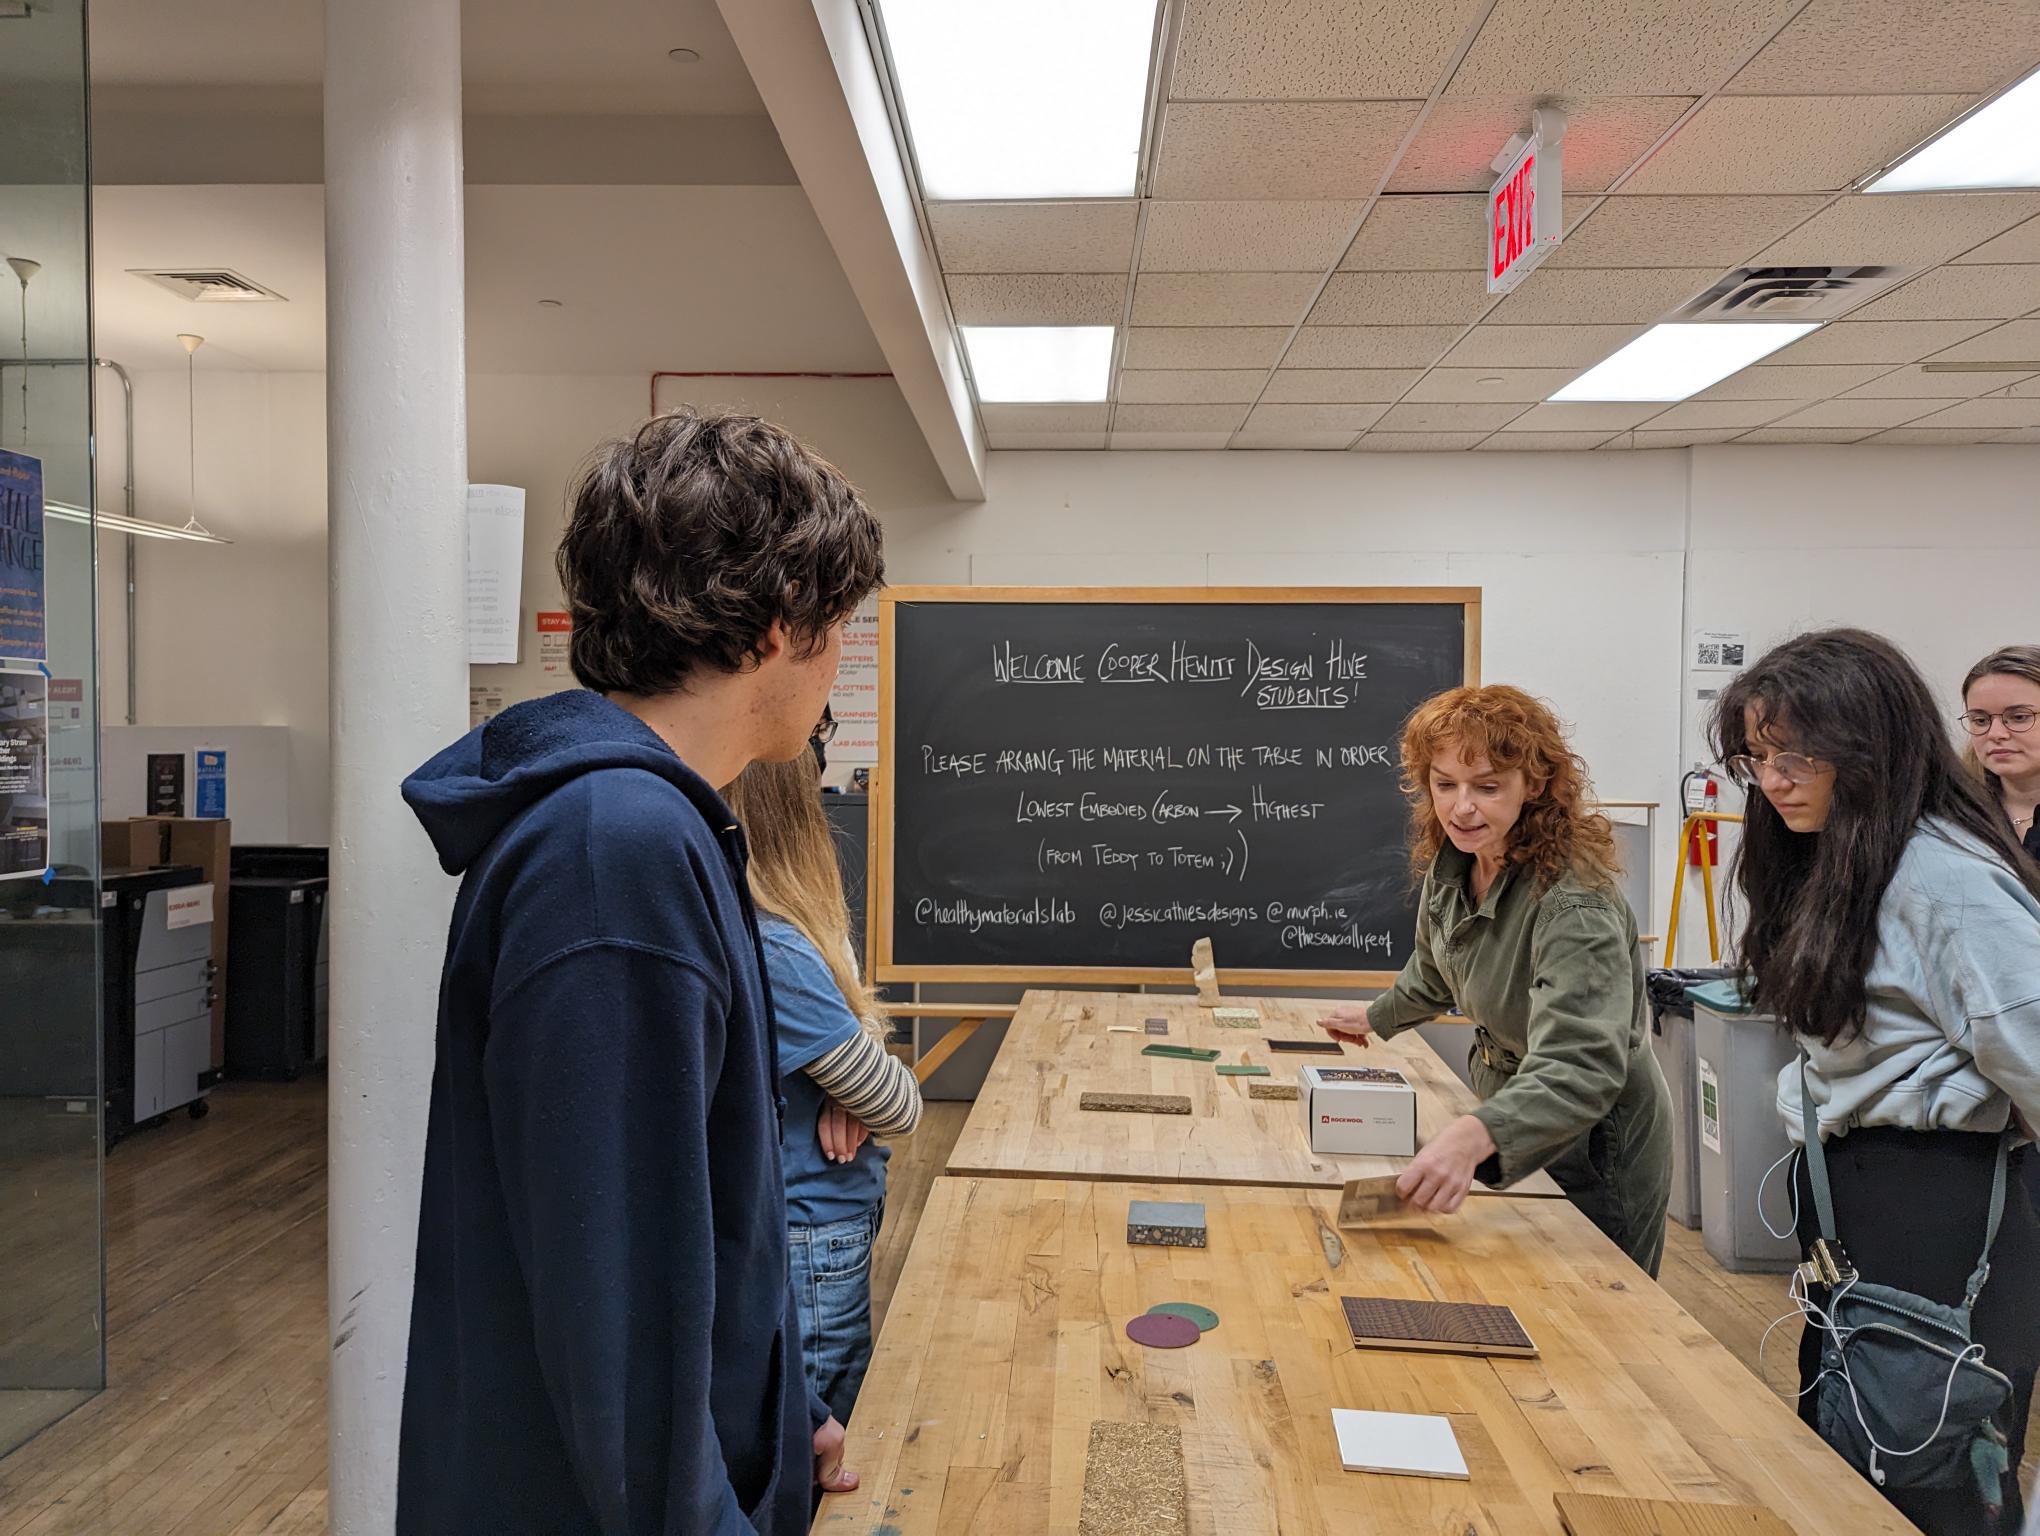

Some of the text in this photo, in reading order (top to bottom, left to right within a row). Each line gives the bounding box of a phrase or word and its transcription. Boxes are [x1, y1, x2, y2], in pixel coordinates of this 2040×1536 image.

[1494, 154, 1534, 279] EXIT
[993, 638, 1367, 697] WELCOME COOPER HEWITT DESIGN HIVE
[1257, 682, 1358, 708] STUDENTS!
[922, 744, 1391, 777] PLEASE ARRANG THE MATERIAL ON THE TABLE IN ORDER
[1017, 784, 1324, 824] LOWEST EMBODIED CARBON HIGHEST
[1038, 838, 1083, 872] (FROM
[1092, 844, 1139, 870] TEDDY
[1147, 852, 1164, 866] TO
[1168, 847, 1214, 868] TOTEM
